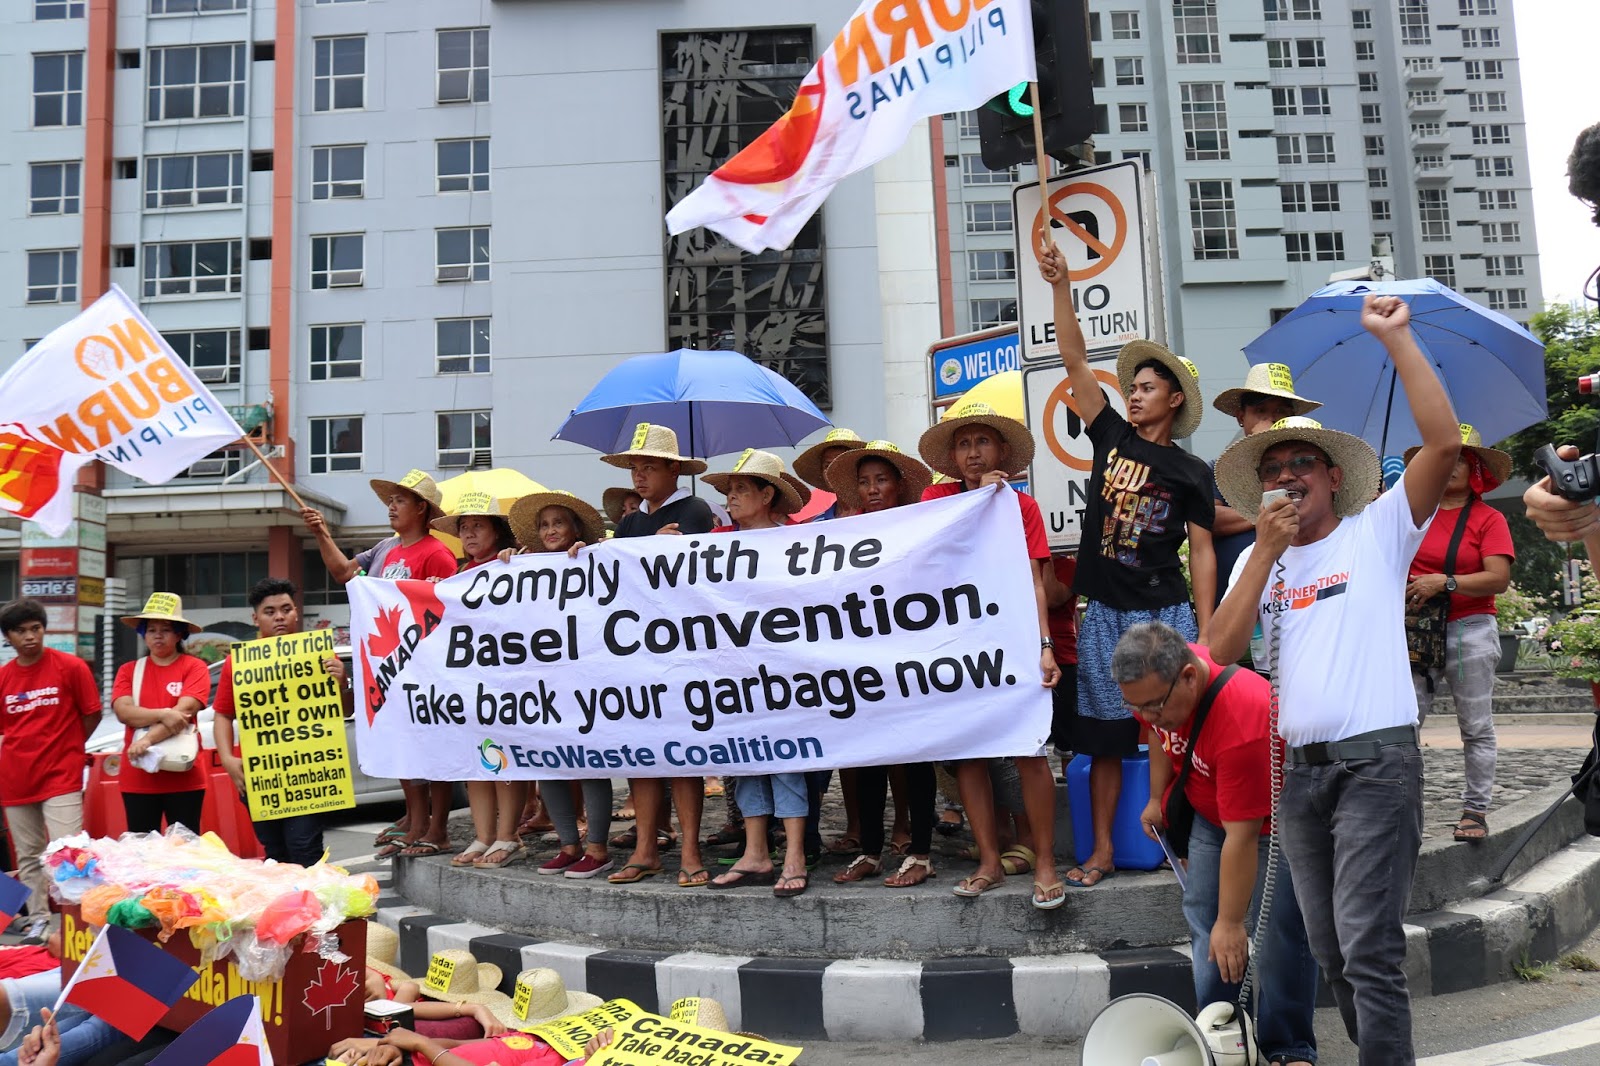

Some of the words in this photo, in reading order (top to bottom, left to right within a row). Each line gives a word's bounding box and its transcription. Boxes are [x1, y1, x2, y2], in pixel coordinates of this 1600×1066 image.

[1088, 310, 1137, 337] TURN
[1118, 333, 1139, 342] MMDA
[1068, 478, 1090, 506] N
[461, 553, 619, 611] Comply
[640, 540, 759, 590] with
[785, 535, 882, 577] the
[22, 582, 76, 596] earle's
[446, 615, 579, 668] Basel
[603, 584, 1000, 656] Convention.
[231, 642, 271, 664] Time
[276, 637, 298, 657] for
[303, 630, 333, 653] rich
[369, 608, 441, 713] CANADA
[234, 658, 313, 686] countries
[318, 655, 326, 674] t
[7, 697, 59, 714] Coalition
[239, 683, 289, 708] sort
[297, 676, 336, 700] out
[402, 683, 466, 726] Take
[476, 680, 562, 726] back
[574, 682, 667, 734] your
[684, 664, 886, 731] garbage
[895, 648, 1016, 698] now.
[240, 706, 290, 730] their
[297, 702, 340, 722] own
[256, 723, 333, 746] mess.
[248, 748, 343, 772] Pilipinas:
[509, 743, 655, 769] EcoWaste
[663, 735, 823, 766] Coalition
[251, 773, 283, 792] Hindi
[286, 766, 346, 787] tambakan
[260, 792, 280, 809] ng
[284, 784, 342, 803] basura.
[269, 805, 308, 816] EcoWaste
[310, 800, 345, 811] Coalition
[65, 913, 96, 961] Ret
[613, 1033, 662, 1057] Take
[661, 1045, 718, 1066] back
[631, 1017, 784, 1064] Canada:
